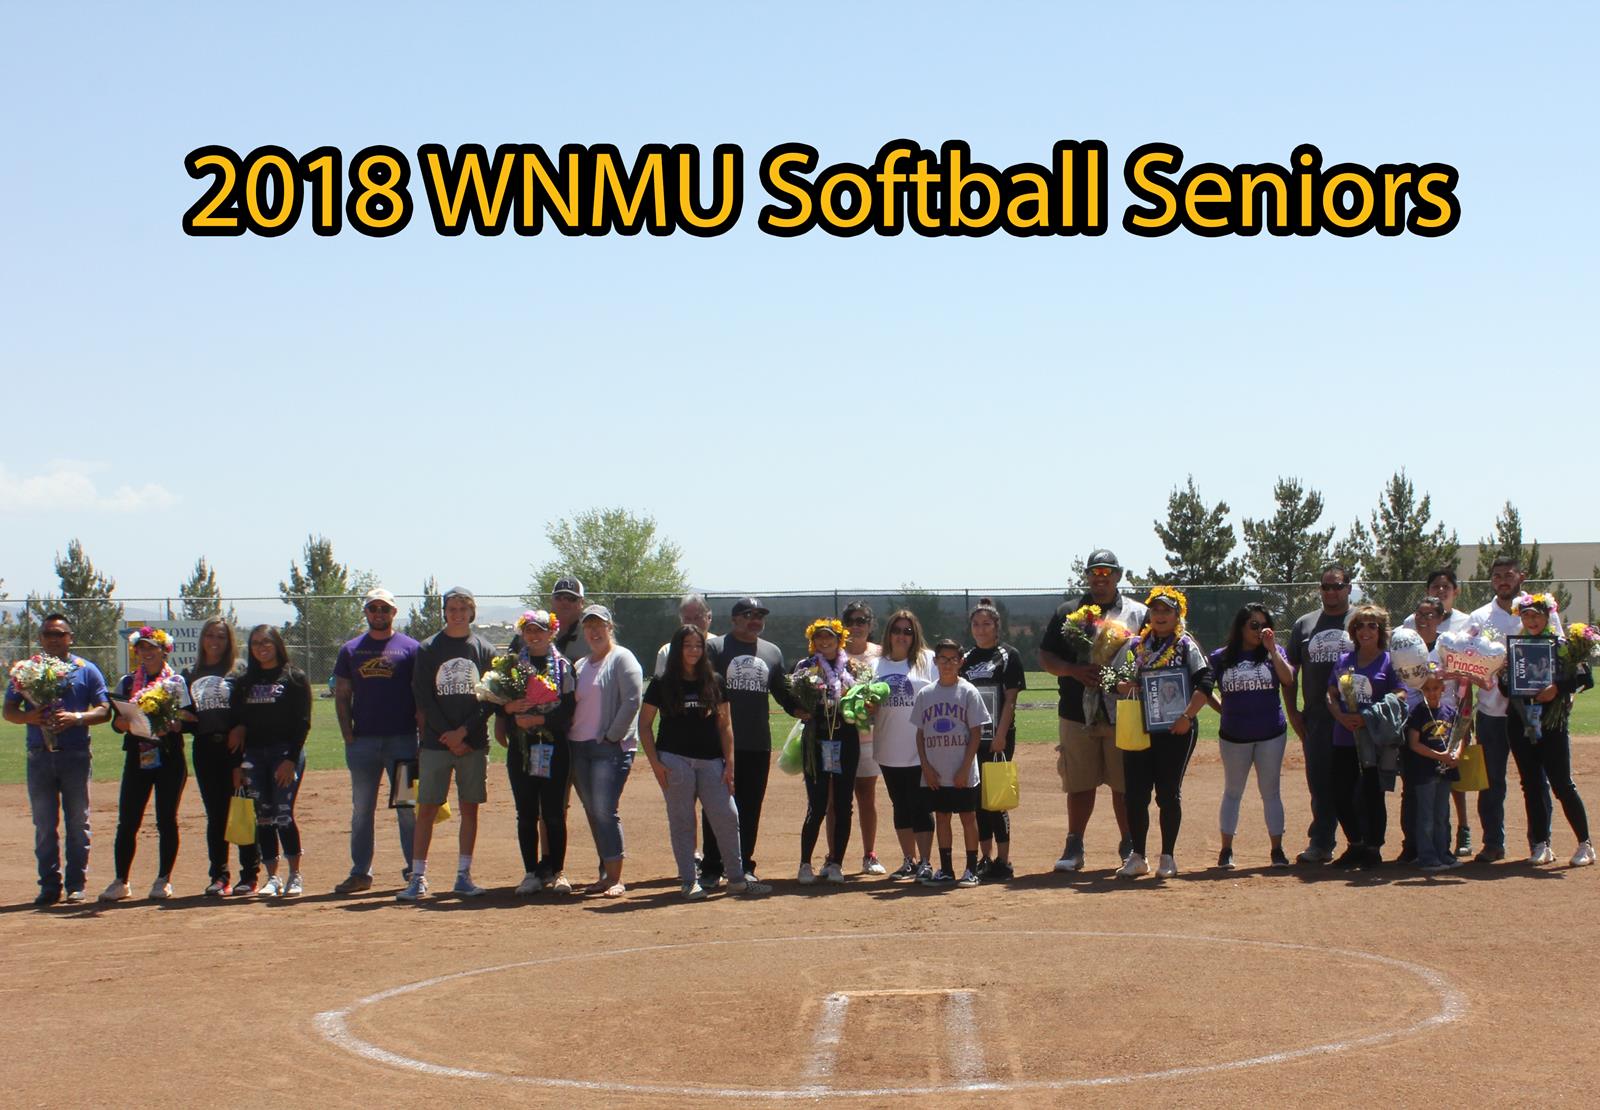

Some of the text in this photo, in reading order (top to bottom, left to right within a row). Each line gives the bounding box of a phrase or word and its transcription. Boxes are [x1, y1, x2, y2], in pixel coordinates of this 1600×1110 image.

[1446, 654, 1489, 676] Princess
[436, 682, 477, 696] SOFTBAL
[1222, 679, 1275, 692] SOFTBALL
[925, 734, 970, 749] OOTBALL
